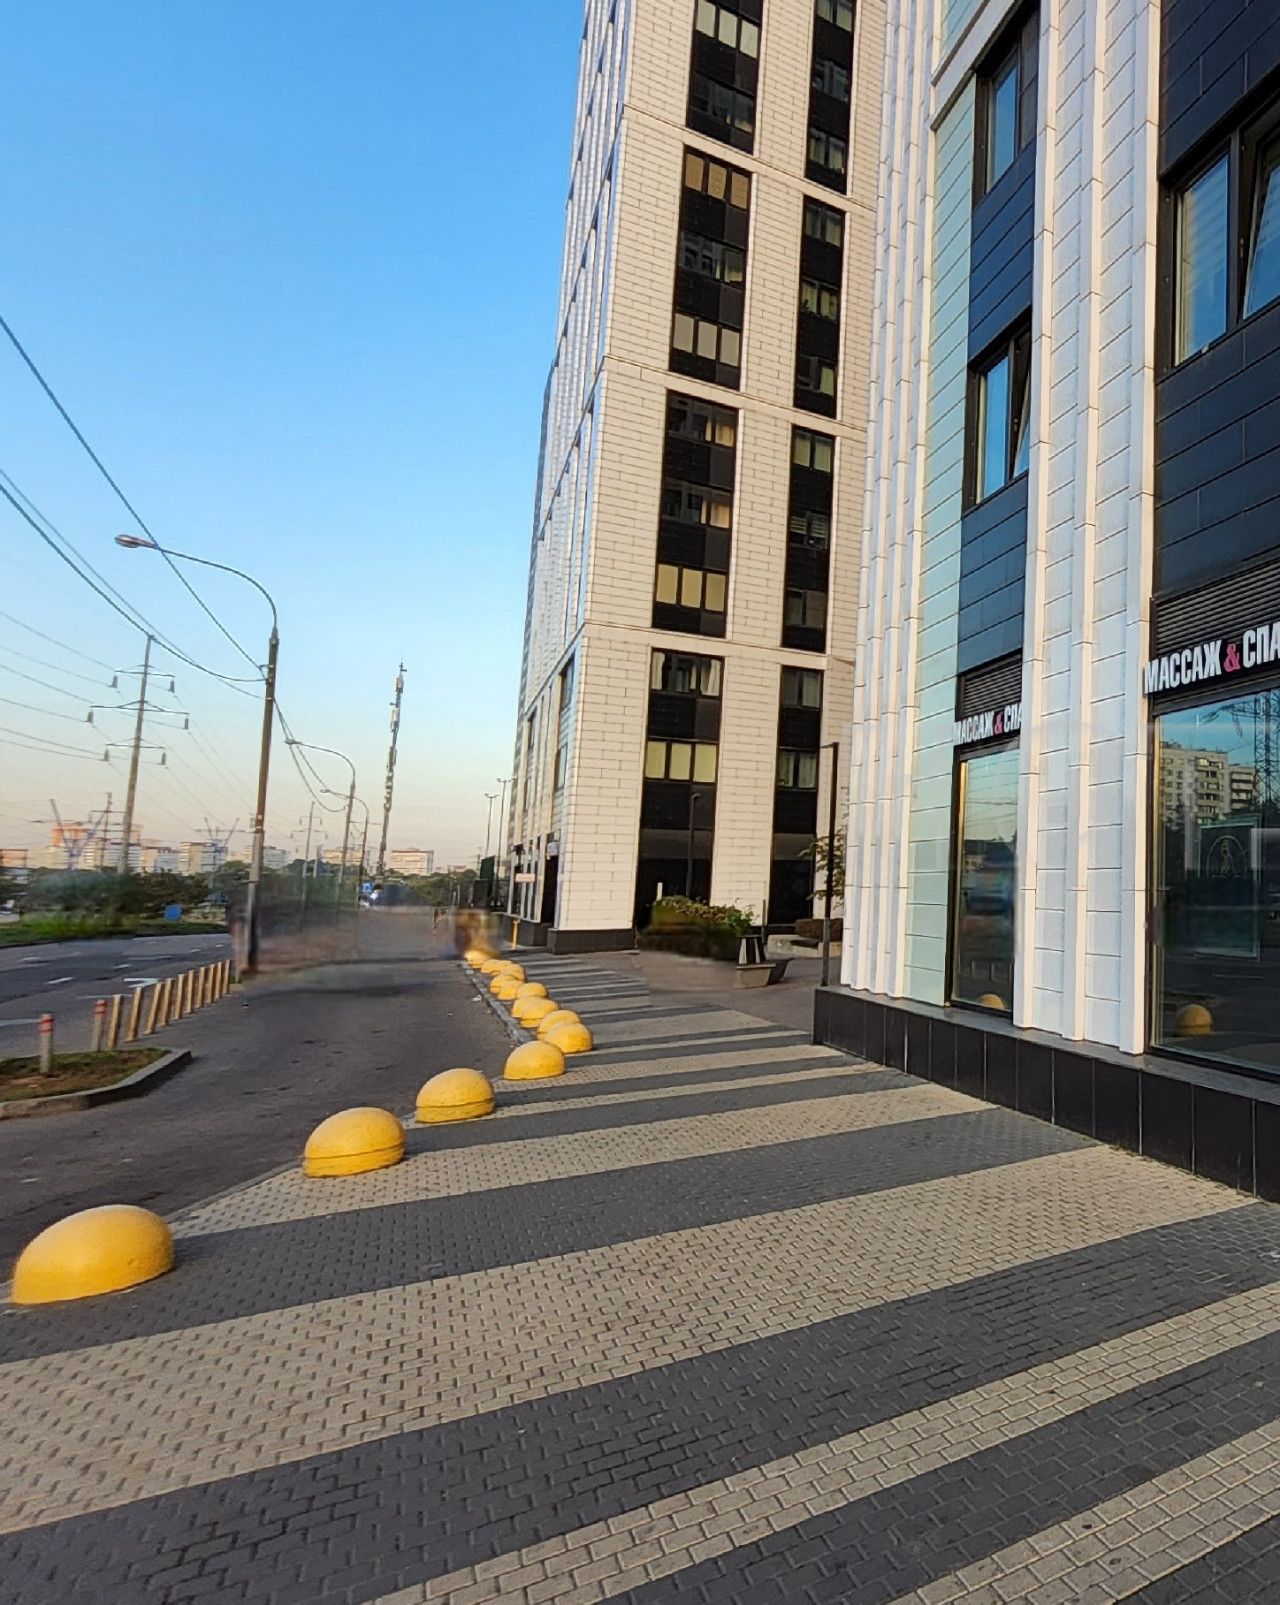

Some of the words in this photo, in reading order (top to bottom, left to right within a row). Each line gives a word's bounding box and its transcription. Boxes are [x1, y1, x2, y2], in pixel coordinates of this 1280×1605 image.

[1144, 639, 1223, 694] МАССАЖ
[1223, 643, 1241, 673] &
[953, 710, 995, 746] МАССАЖ
[994, 711, 1004, 735] &
